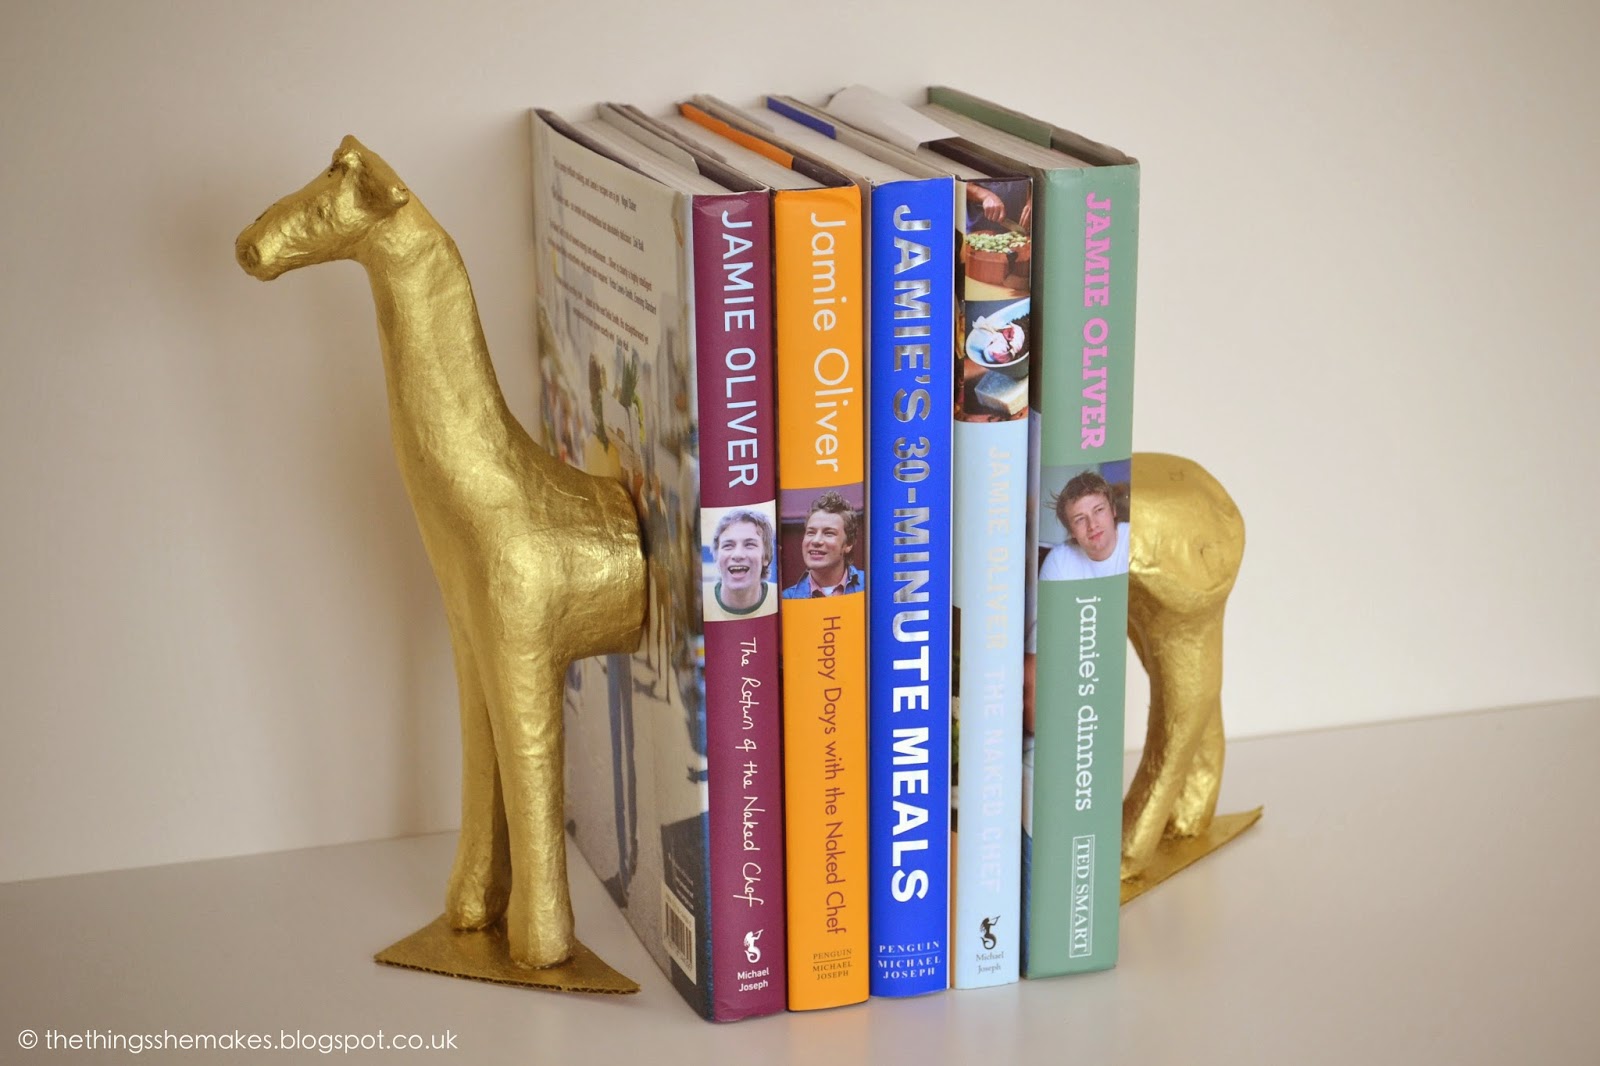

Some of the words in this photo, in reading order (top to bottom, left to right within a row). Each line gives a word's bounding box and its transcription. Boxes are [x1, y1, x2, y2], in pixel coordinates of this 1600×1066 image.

[721, 210, 755, 332] JAMIE
[810, 212, 847, 331] Jamie
[1084, 191, 1111, 307] JAMIE
[893, 204, 931, 423] JAMIE'S
[1081, 317, 1109, 450] OLIVER
[725, 347, 759, 488] OLIVER
[813, 348, 853, 472] Oliver
[987, 445, 1010, 536] JAMIE
[892, 436, 931, 713] 30-MINUTE
[985, 546, 1009, 650] OLIVER
[740, 637, 757, 667] The
[818, 616, 841, 681] Happy
[1075, 596, 1101, 697] jamie's
[739, 677, 761, 730] Return
[818, 687, 842, 735] Days
[735, 738, 757, 752] of
[824, 741, 845, 780] with
[1075, 705, 1099, 811] dinners
[743, 761, 758, 789] the
[743, 797, 765, 851] Naked
[825, 787, 845, 815] the
[891, 727, 930, 902] MEALS
[825, 821, 846, 884] Naked
[1075, 838, 1092, 879] TED
[733, 862, 764, 907] Chef
[826, 891, 846, 935] Chef
[1073, 884, 1091, 954] SMART
[812, 949, 852, 960] PENGUIN
[812, 960, 853, 972] MICHAEL
[878, 955, 941, 968] MICHAEL
[879, 941, 940, 953] PENGUIN
[976, 951, 1004, 962] Michael
[977, 963, 1001, 974] Joseph
[737, 967, 770, 981] Michael
[738, 980, 769, 992] Joseph
[816, 970, 849, 981] JOSEPH
[883, 967, 936, 979] JOSEPH
